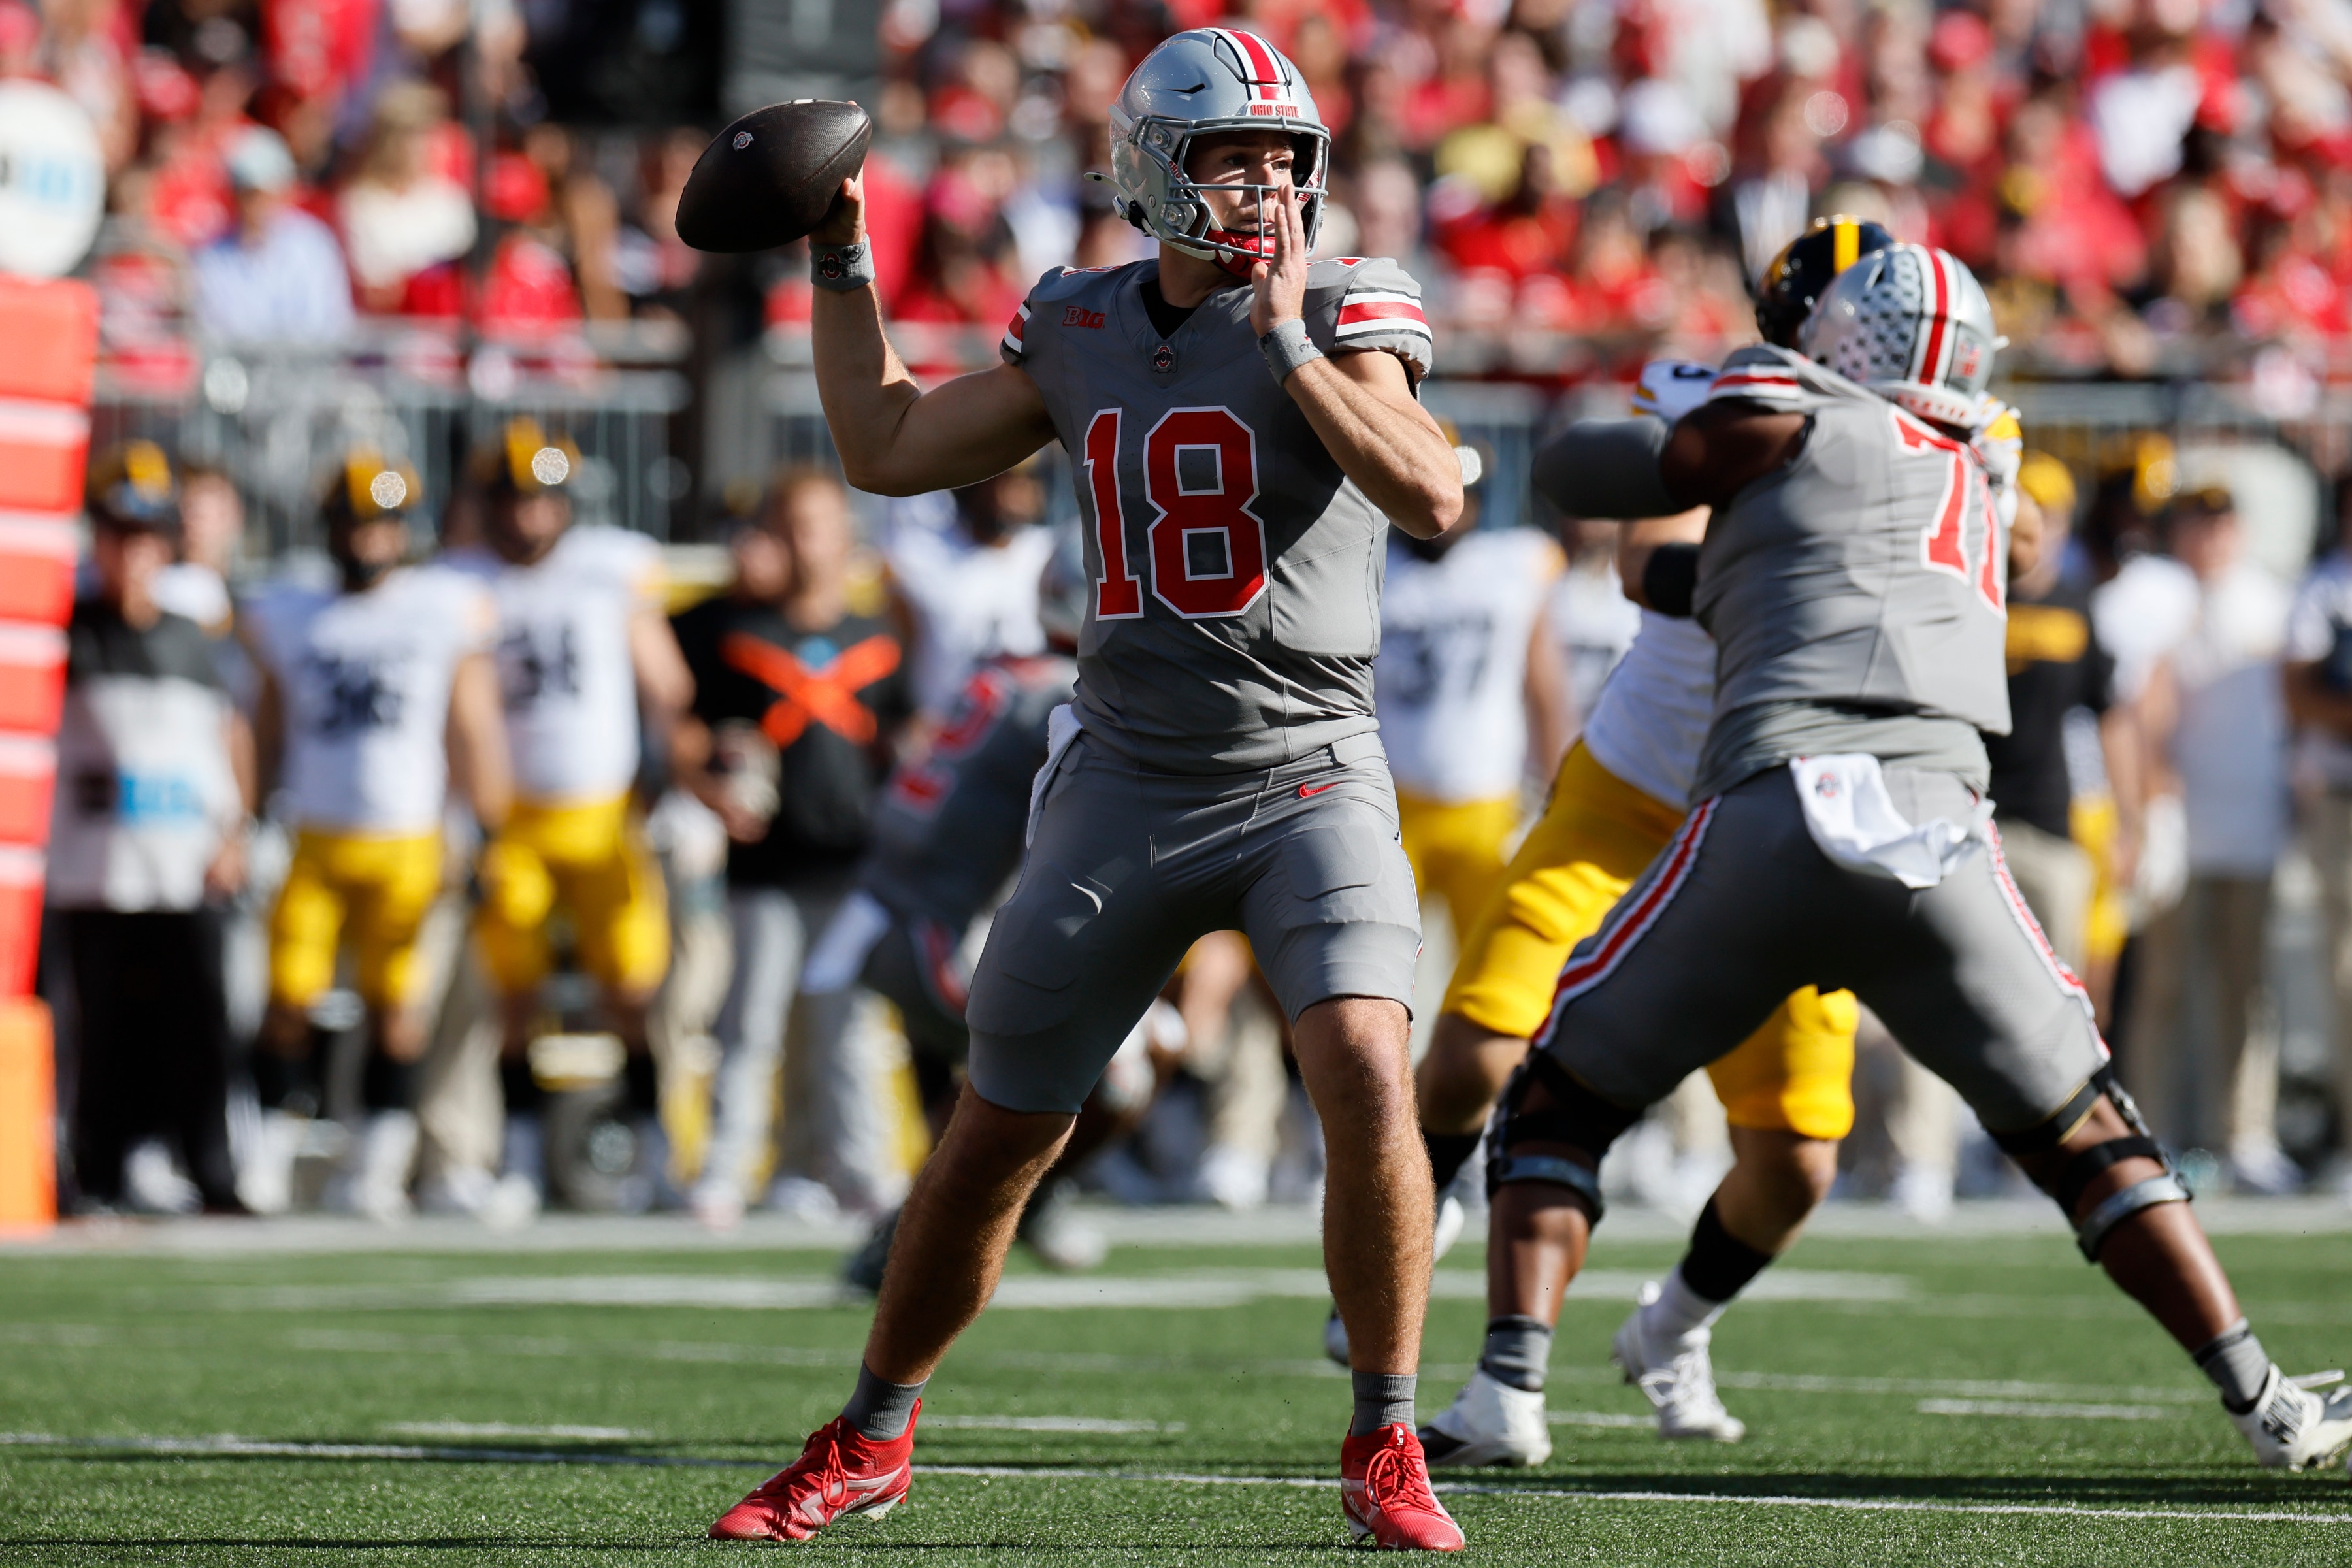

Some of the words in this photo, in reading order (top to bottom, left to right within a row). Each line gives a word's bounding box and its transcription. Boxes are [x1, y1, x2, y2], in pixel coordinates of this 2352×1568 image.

[1251, 104, 1273, 116] OHIO
[1276, 105, 1299, 118] STATE
[1083, 405, 1271, 622] 18
